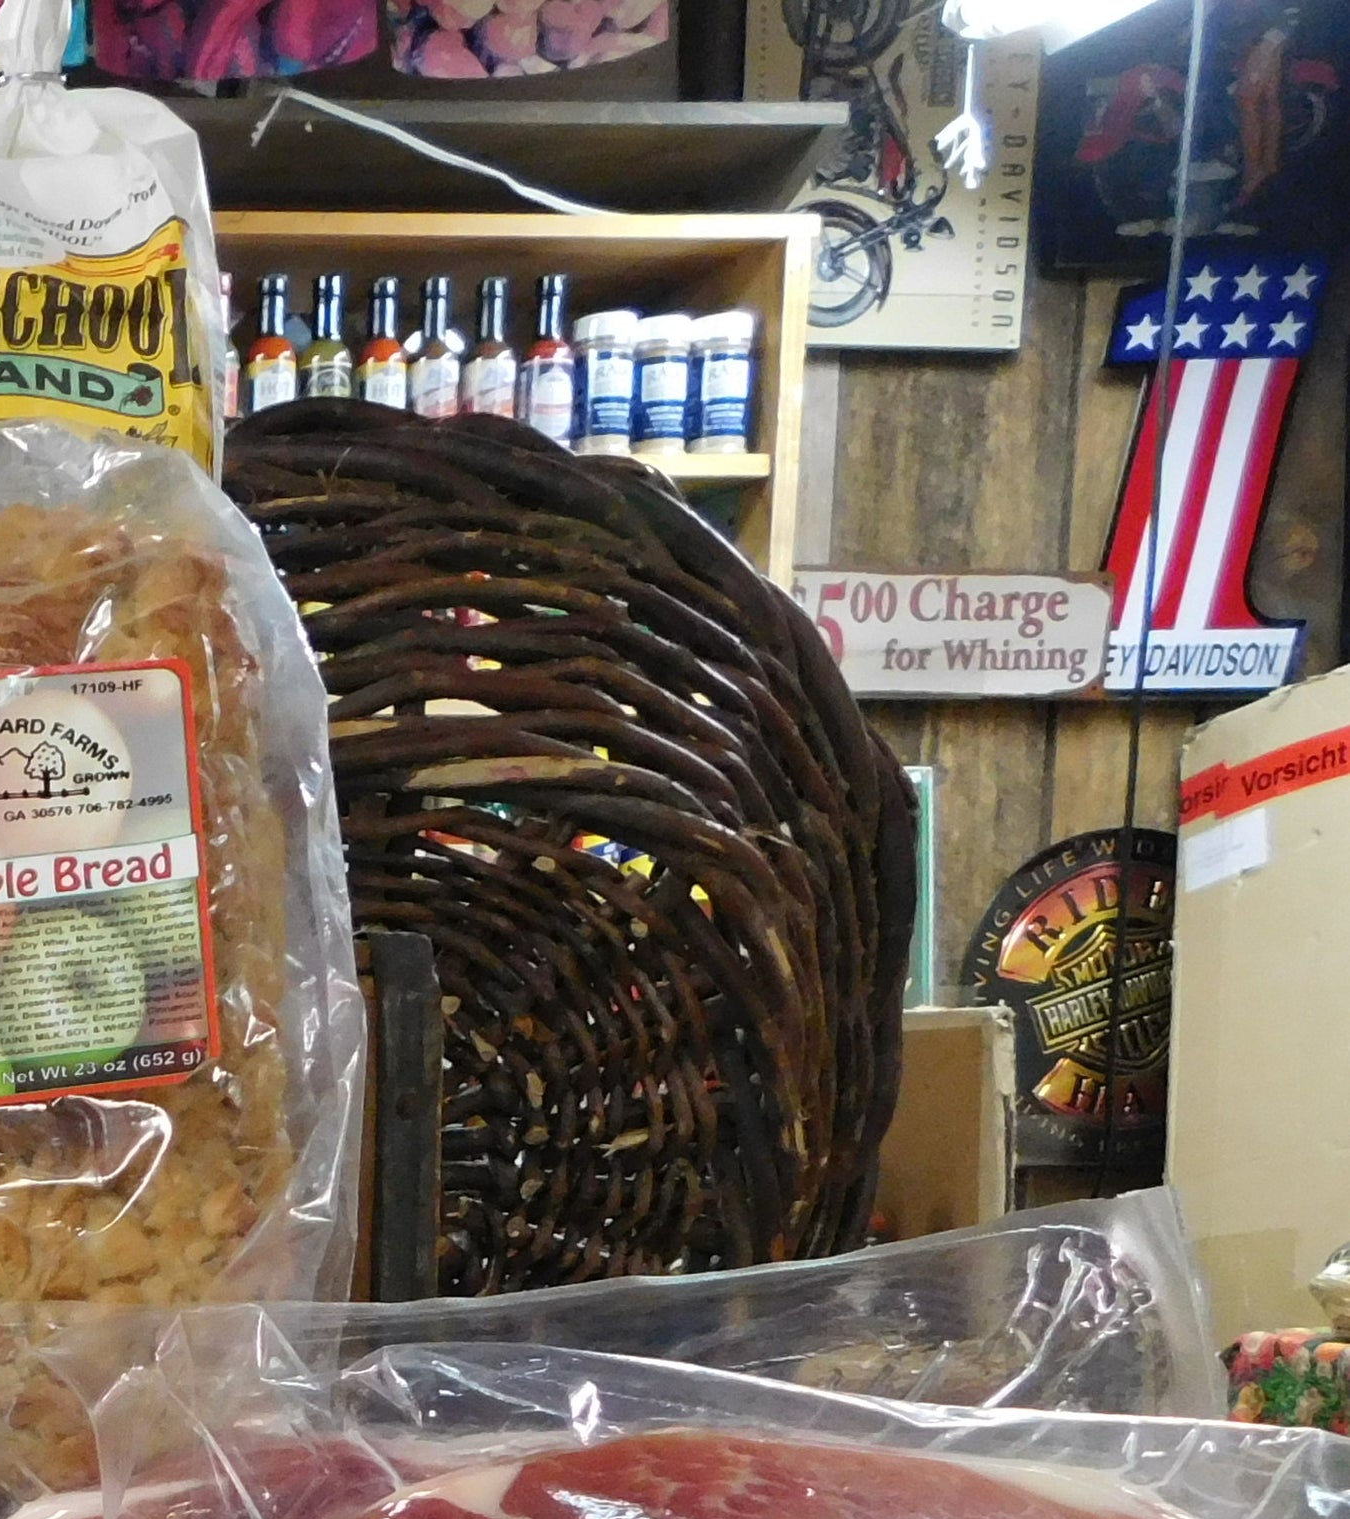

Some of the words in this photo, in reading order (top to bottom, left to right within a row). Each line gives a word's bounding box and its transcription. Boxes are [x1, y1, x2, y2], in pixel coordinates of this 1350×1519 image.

[909, 577, 1070, 638] Charge
[882, 640, 933, 671] for
[944, 640, 1088, 682] Whining
[1143, 642, 1277, 677] DAVIDSON
[50, 722, 120, 771] FARMS
[1241, 742, 1349, 799] Vorsicht
[72, 770, 131, 785] GROWN
[53, 842, 173, 893] Bread
[1016, 849, 1078, 898] LIFE
[2, 1070, 36, 1085] Net
[40, 1065, 68, 1082] Wt
[74, 1062, 98, 1078] 23
[103, 1060, 127, 1074] oz
[133, 1051, 175, 1071] (652
[180, 1047, 202, 1067] g)
